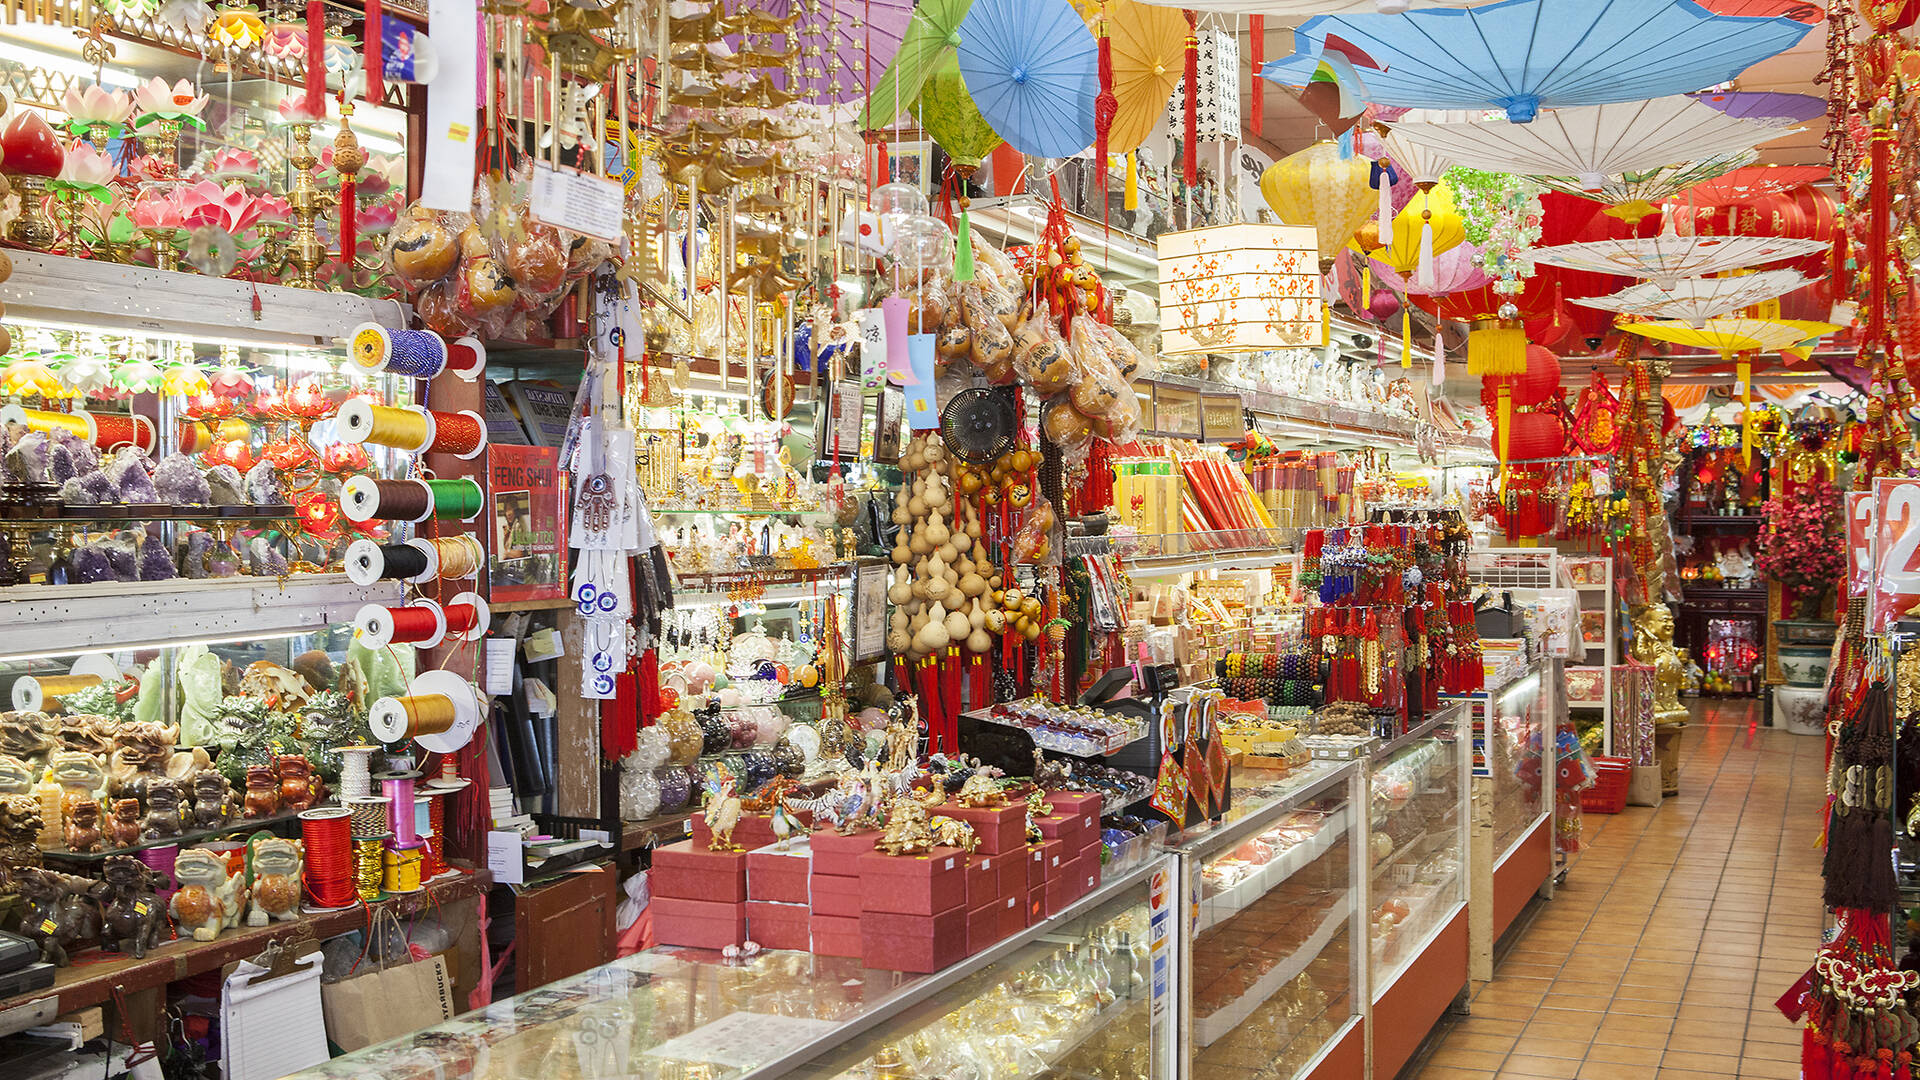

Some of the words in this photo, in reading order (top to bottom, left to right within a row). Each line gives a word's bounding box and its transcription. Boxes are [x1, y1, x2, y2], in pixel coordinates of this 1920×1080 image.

[495, 466, 523, 487] FENG
[526, 467, 552, 488] SHUI
[435, 962, 449, 1020] STARBUCKS
